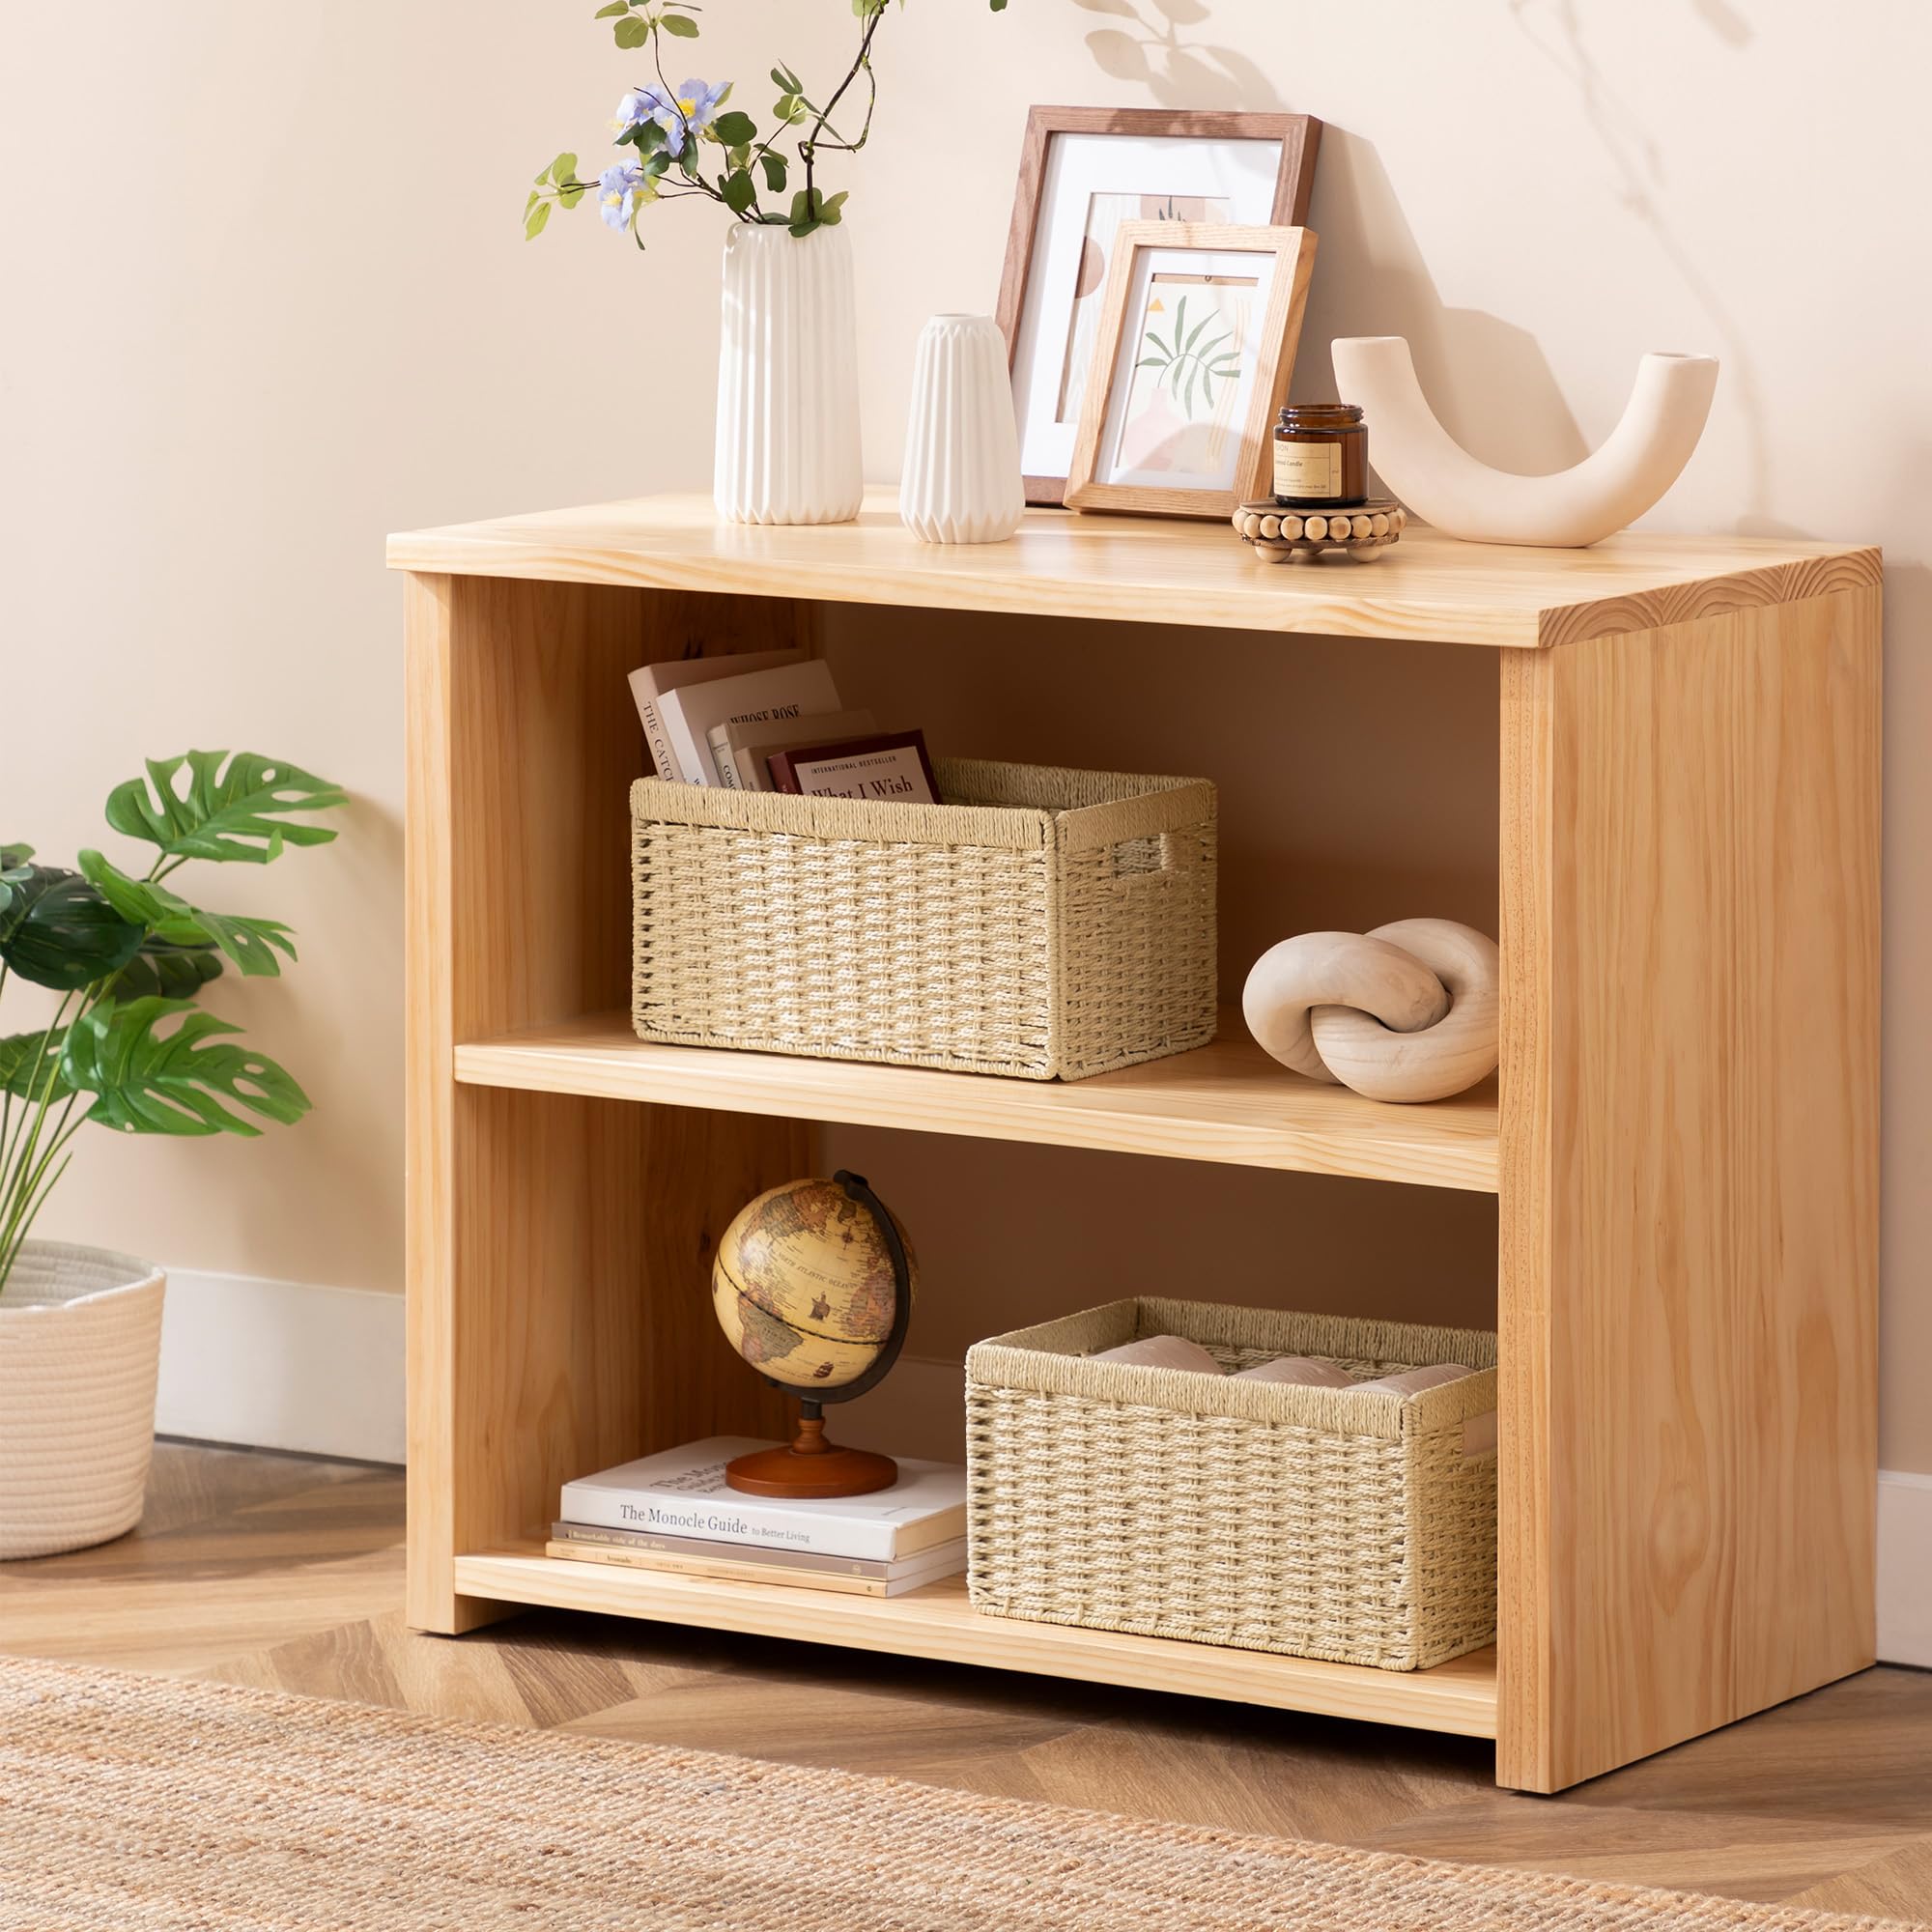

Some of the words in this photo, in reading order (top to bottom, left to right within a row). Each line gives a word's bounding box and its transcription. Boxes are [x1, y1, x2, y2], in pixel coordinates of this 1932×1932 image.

[643, 700, 659, 734] THE
[723, 764, 737, 790] COM
[811, 762, 858, 774] INTERNATIONAL
[858, 755, 897, 768] BESTSELLER
[858, 782, 867, 800] I
[869, 775, 914, 797] Wish
[620, 1503, 645, 1521] The
[648, 1508, 705, 1529] Monocle
[708, 1516, 748, 1534] Guide
[761, 1528, 784, 1540] Better
[785, 1532, 810, 1544] Living
